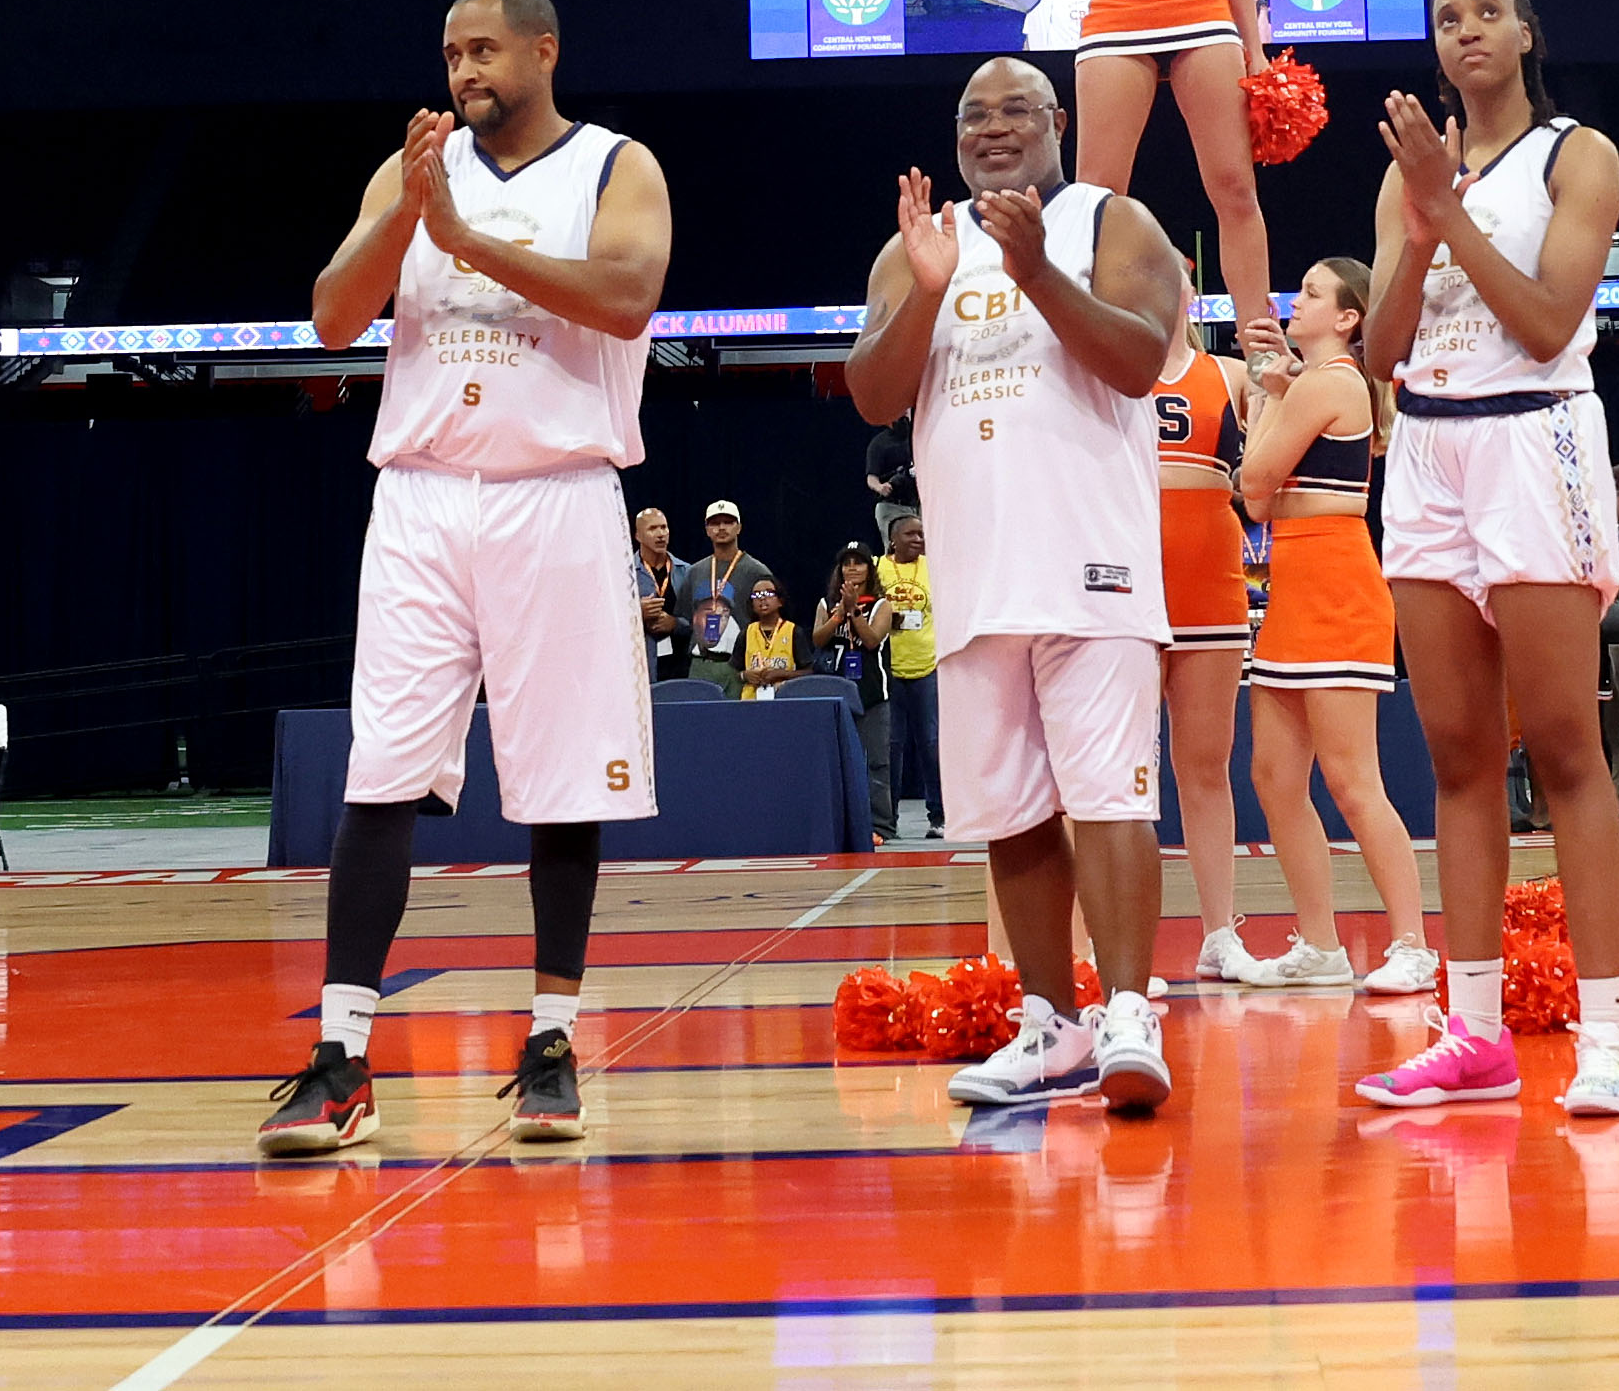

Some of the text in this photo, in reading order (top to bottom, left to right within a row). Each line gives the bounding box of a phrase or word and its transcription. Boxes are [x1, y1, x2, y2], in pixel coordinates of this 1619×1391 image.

[1273, 28, 1364, 38] COMMUNITY FOUNDATION
[1284, 21, 1315, 29] CENTRAL
[813, 44, 857, 52] COMMUNITY
[823, 36, 854, 44] CENTRAL
[1440, 274, 1471, 291] 202
[648, 314, 687, 335] CK
[427, 329, 542, 350] CELEBRITY
[438, 348, 521, 368] CLASSIC
[1433, 368, 1449, 388] S
[462, 383, 482, 407] S
[950, 383, 1026, 408] CLASSIC
[1155, 394, 1192, 443] S
[979, 418, 995, 441] S
[835, 644, 845, 672] 7
[606, 760, 631, 791] S
[1133, 766, 1149, 796] S
